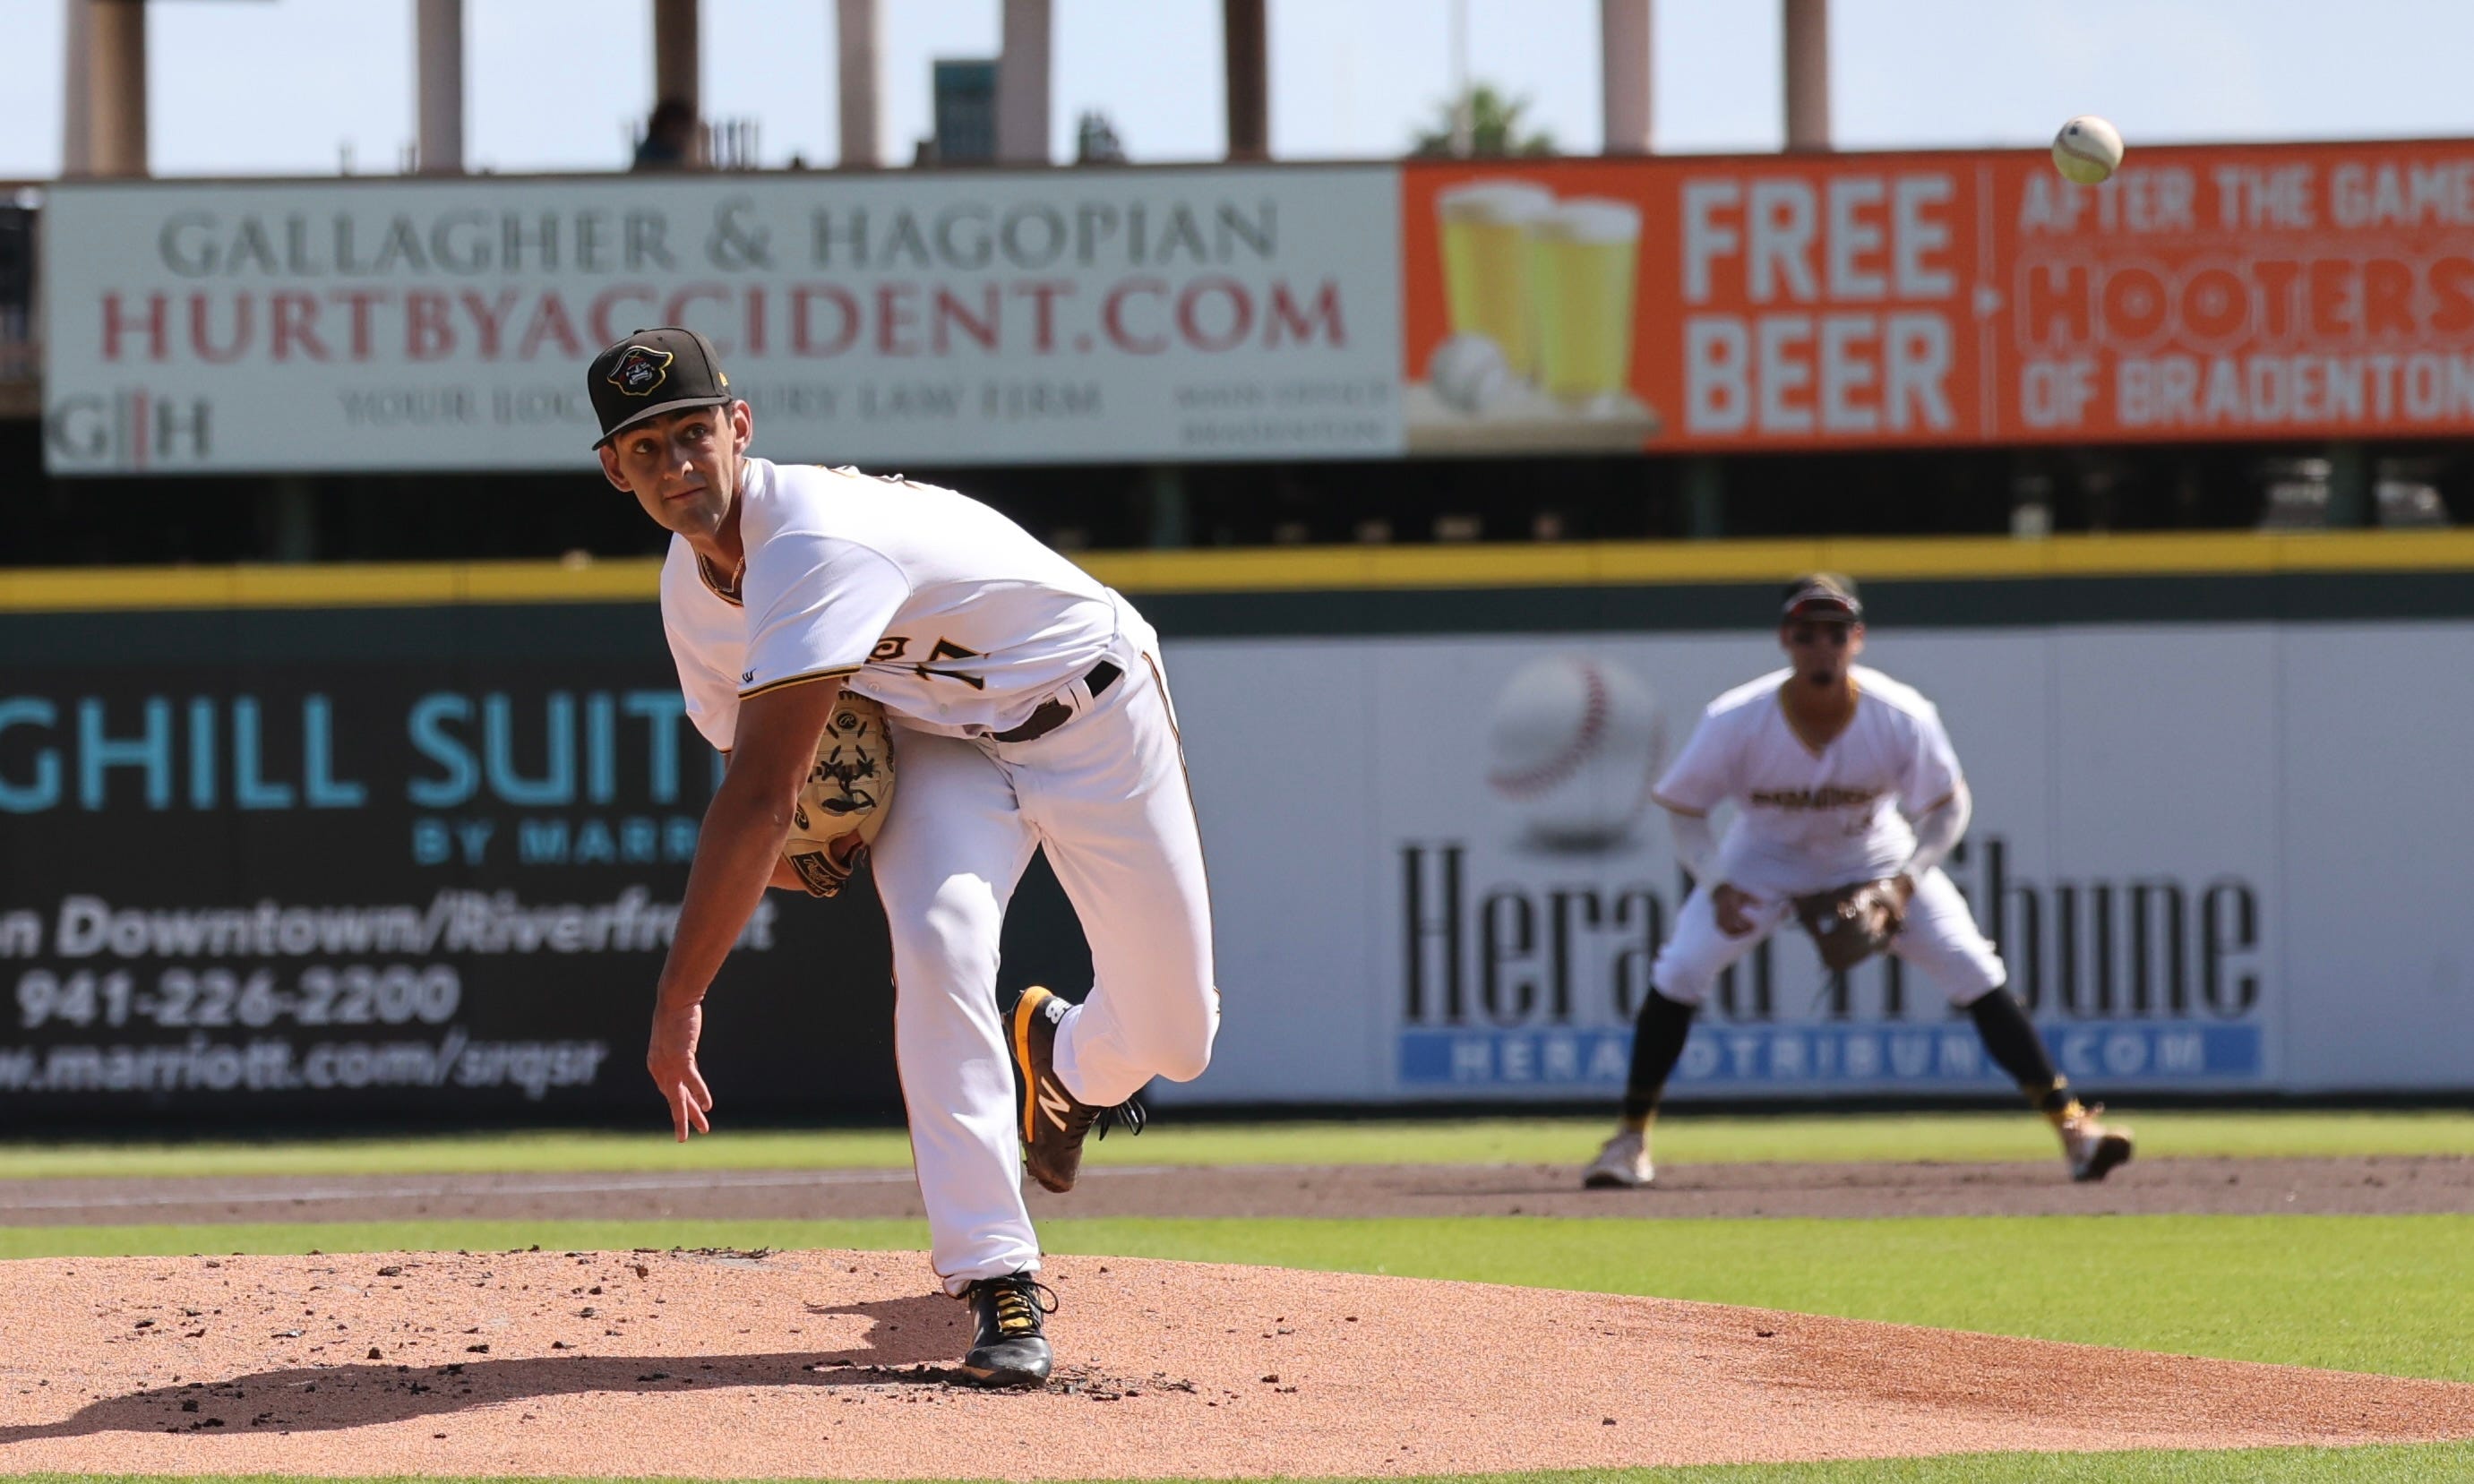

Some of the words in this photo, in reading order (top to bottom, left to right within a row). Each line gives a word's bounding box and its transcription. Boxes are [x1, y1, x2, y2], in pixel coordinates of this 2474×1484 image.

[159, 205, 677, 276] GALLAGHER
[704, 196, 772, 271] &
[811, 198, 1280, 271] HAGOPIAN
[2020, 167, 2197, 235] AFTER
[2210, 160, 2317, 232] THE
[1679, 174, 1956, 305] FREE
[99, 274, 1349, 364] HURTBYACCIDENT.COM
[2023, 253, 2474, 345] HOOTERS
[493, 387, 591, 425] LOC
[1682, 311, 1956, 436] BEER
[2021, 358, 2098, 428] OF
[2116, 353, 2474, 426] BRADENTON
[406, 691, 726, 807] SUIT
[412, 818, 495, 866] BY
[518, 817, 697, 865] MARR
[56, 887, 777, 958] Downtown/Riverfrt
[16, 965, 463, 1028] 941-226-2200
